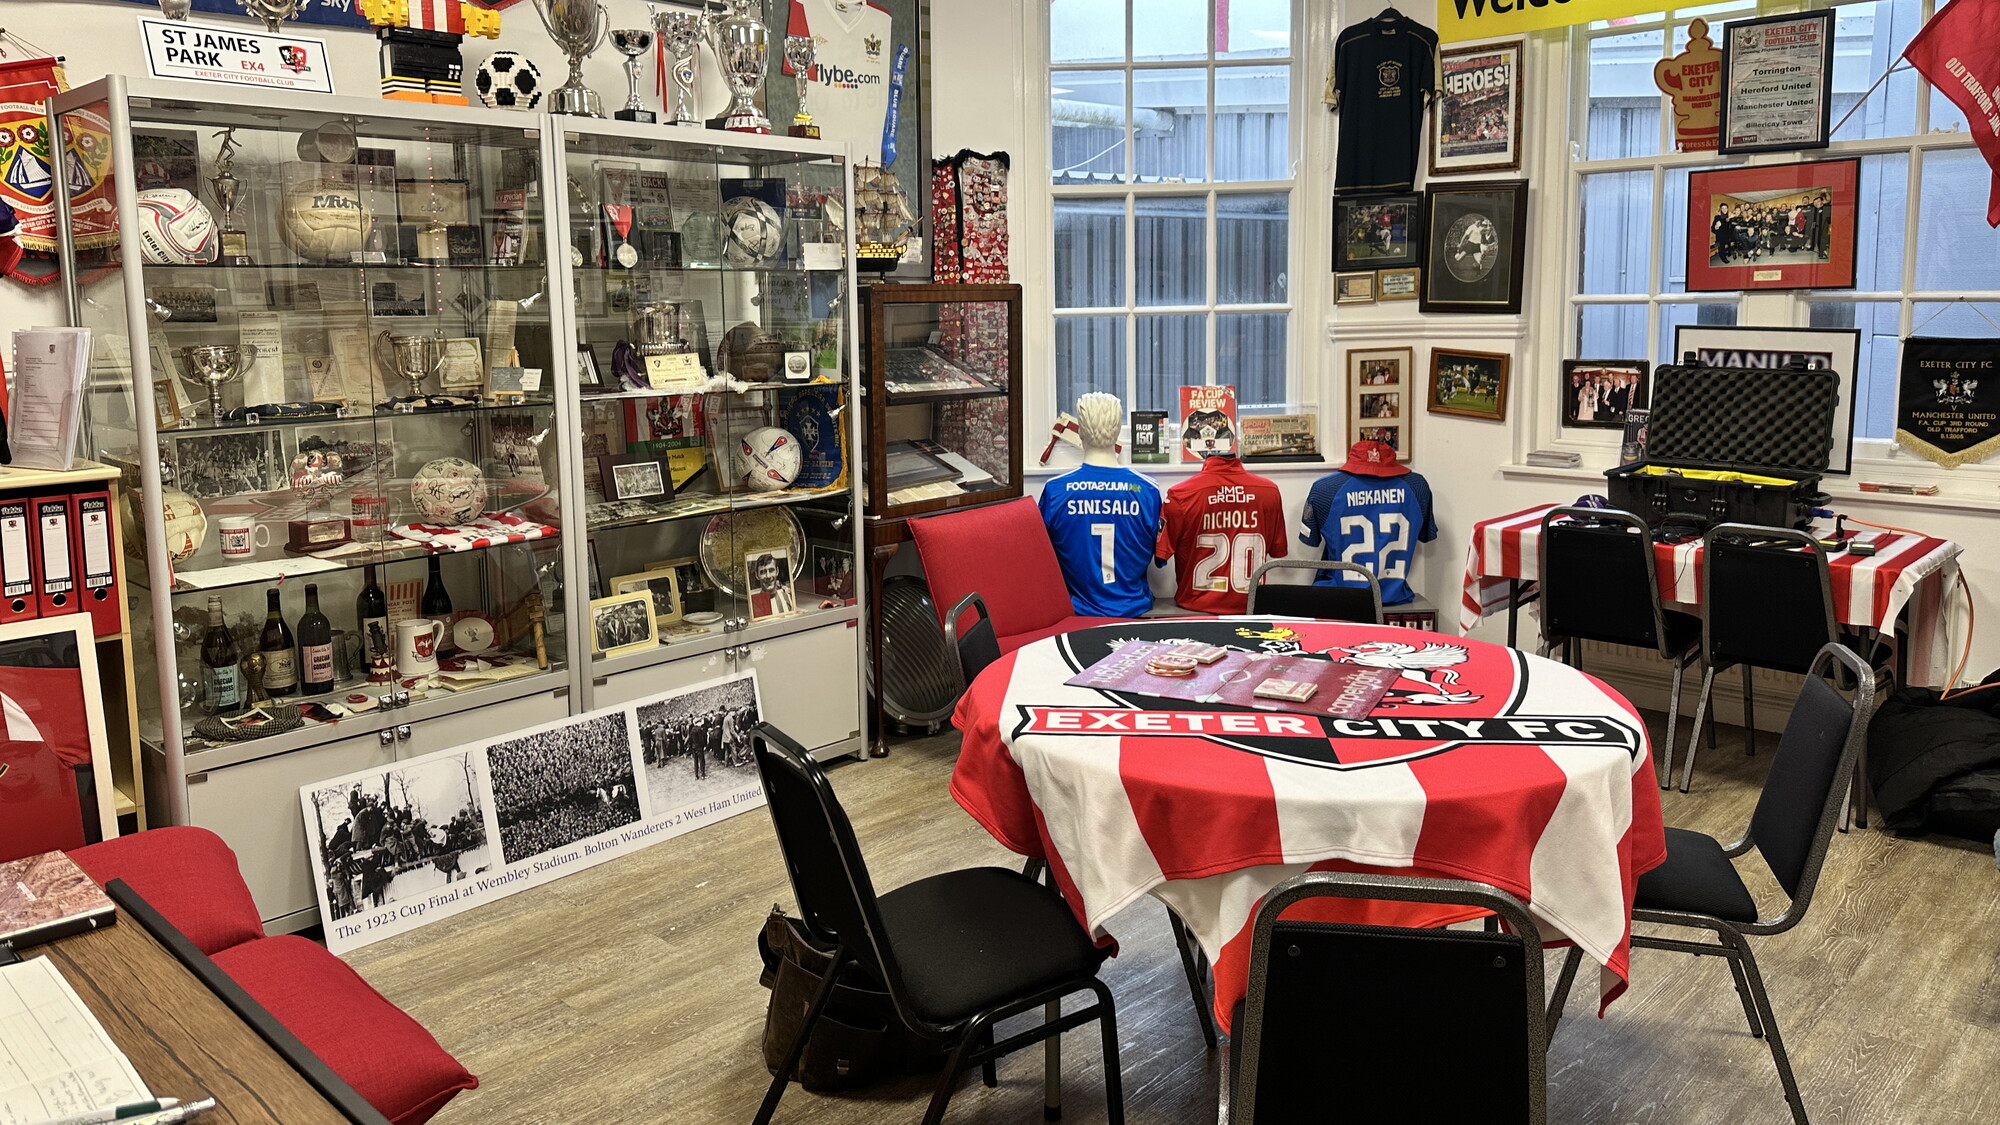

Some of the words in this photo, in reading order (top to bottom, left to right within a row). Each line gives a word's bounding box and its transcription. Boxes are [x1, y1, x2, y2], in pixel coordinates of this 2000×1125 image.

[1765, 25, 1796, 36] EXETER
[1799, 23, 1818, 32] CITY
[162, 29, 187, 45] ST
[193, 33, 261, 54] JAMES
[1765, 36, 1797, 46] FOOTBALL
[1799, 33, 1817, 41] CLUB
[165, 47, 223, 68] PARK
[240, 60, 265, 72] EX4
[1682, 61, 1720, 76] EXETER
[1753, 66, 1801, 76] Torrington
[195, 70, 223, 80] EXETER
[223, 73, 239, 81] CITY
[239, 75, 276, 85] FOOTBALL
[276, 79, 295, 87] CLUB
[1443, 65, 1509, 98] HEROES!
[1689, 75, 1713, 88] CITY
[1741, 85, 1779, 95] Hereford
[1782, 82, 1812, 91] United
[1945, 57, 1966, 78] OLD
[1960, 71, 1993, 115] TRAFFORD
[0, 104, 30, 112] FOOTBALL
[1691, 101, 1712, 109] UNITED
[1737, 102, 1784, 111] Manchester
[1786, 99, 1814, 107] United
[889, 109, 898, 138] SQUARE
[1745, 121, 1780, 129] Billericay
[642, 177, 666, 189] BACK!
[312, 194, 363, 210] Mitre
[142, 230, 160, 252] Exeter
[157, 250, 171, 264] City
[1920, 360, 1951, 369] EXETER
[1955, 361, 1977, 369] CITY
[1981, 361, 1993, 369] FC
[1191, 390, 1205, 399] FA
[1206, 390, 1224, 399] CUP
[1189, 399, 1227, 409] REVIEW
[1136, 432, 1154, 445] 150
[1066, 481, 1128, 491] FOOTASYLUM
[1217, 486, 1245, 495] JMC
[1208, 494, 1255, 505] GROUP
[1346, 489, 1405, 507] NISKANEN
[1067, 499, 1140, 516] SINISALO
[1203, 510, 1258, 530] NICHOLS
[1091, 523, 1116, 584] 1
[1340, 512, 1410, 582] 22
[1192, 533, 1267, 594] 20
[1327, 669, 1385, 714] carpetright
[1046, 711, 1311, 735] EXETER
[1332, 718, 1485, 738] CITY
[1507, 720, 1605, 739] FC
[335, 923, 362, 939] The
[365, 910, 397, 930] 1923
[400, 903, 426, 918] Cup
[428, 889, 459, 909] Final
[462, 885, 474, 898] at
[477, 867, 531, 893] Wembley
[533, 852, 582, 874] Stadium.
[584, 838, 618, 857] Bolton
[620, 819, 674, 843] Wanderers
[675, 814, 682, 824] 2
[684, 806, 708, 821] West
[709, 799, 731, 813] Ham
[733, 786, 762, 805] United
